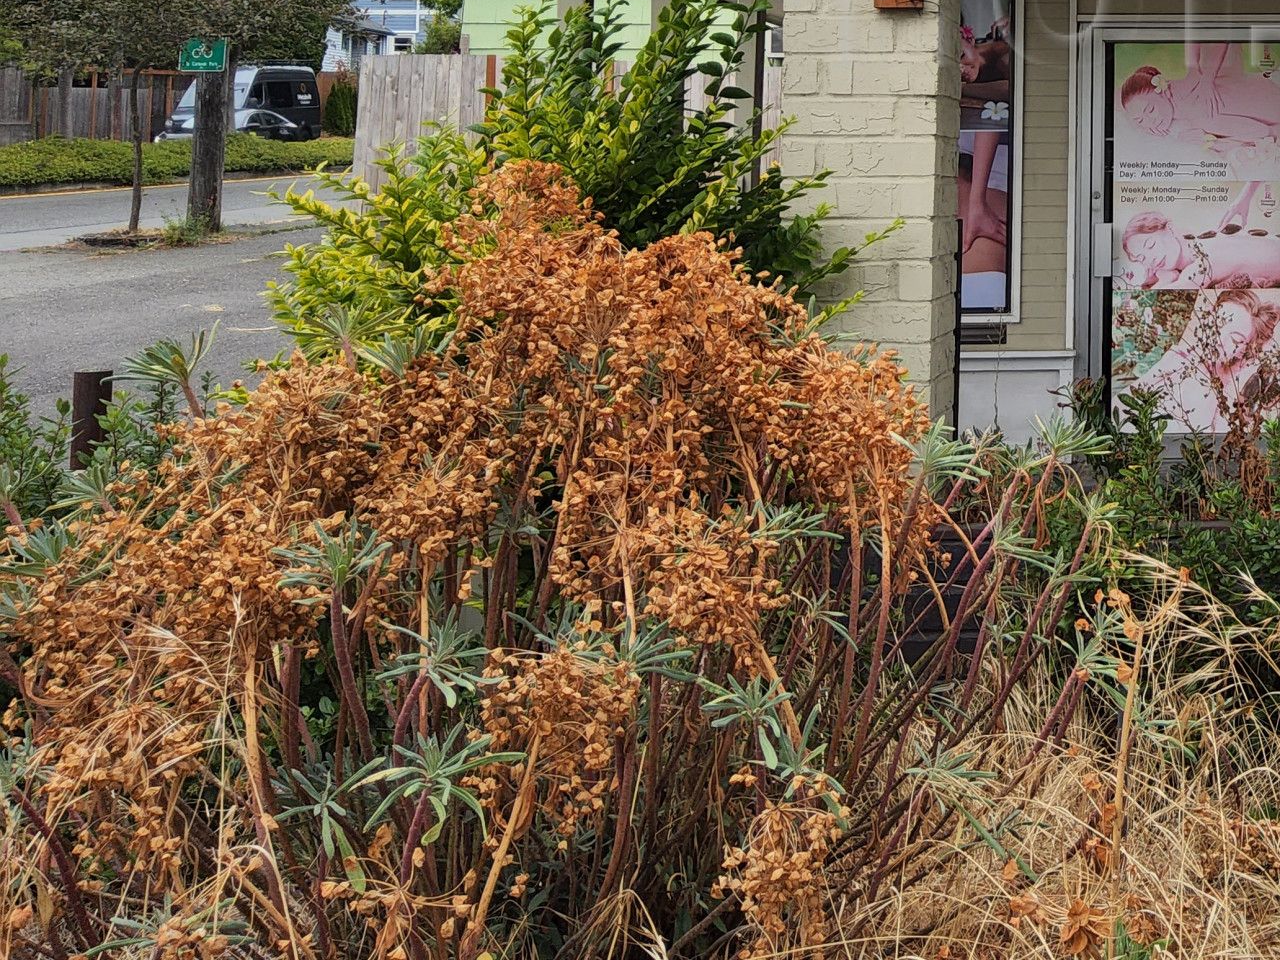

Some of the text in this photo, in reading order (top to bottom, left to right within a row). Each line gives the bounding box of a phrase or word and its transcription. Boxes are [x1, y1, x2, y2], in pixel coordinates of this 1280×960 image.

[1119, 161, 1228, 170] Weekly: Monday Sunday
[1119, 170, 1227, 179] Day: Am10:00 Pm10:00
[1120, 186, 1229, 195] Weekly: Monday Sunday
